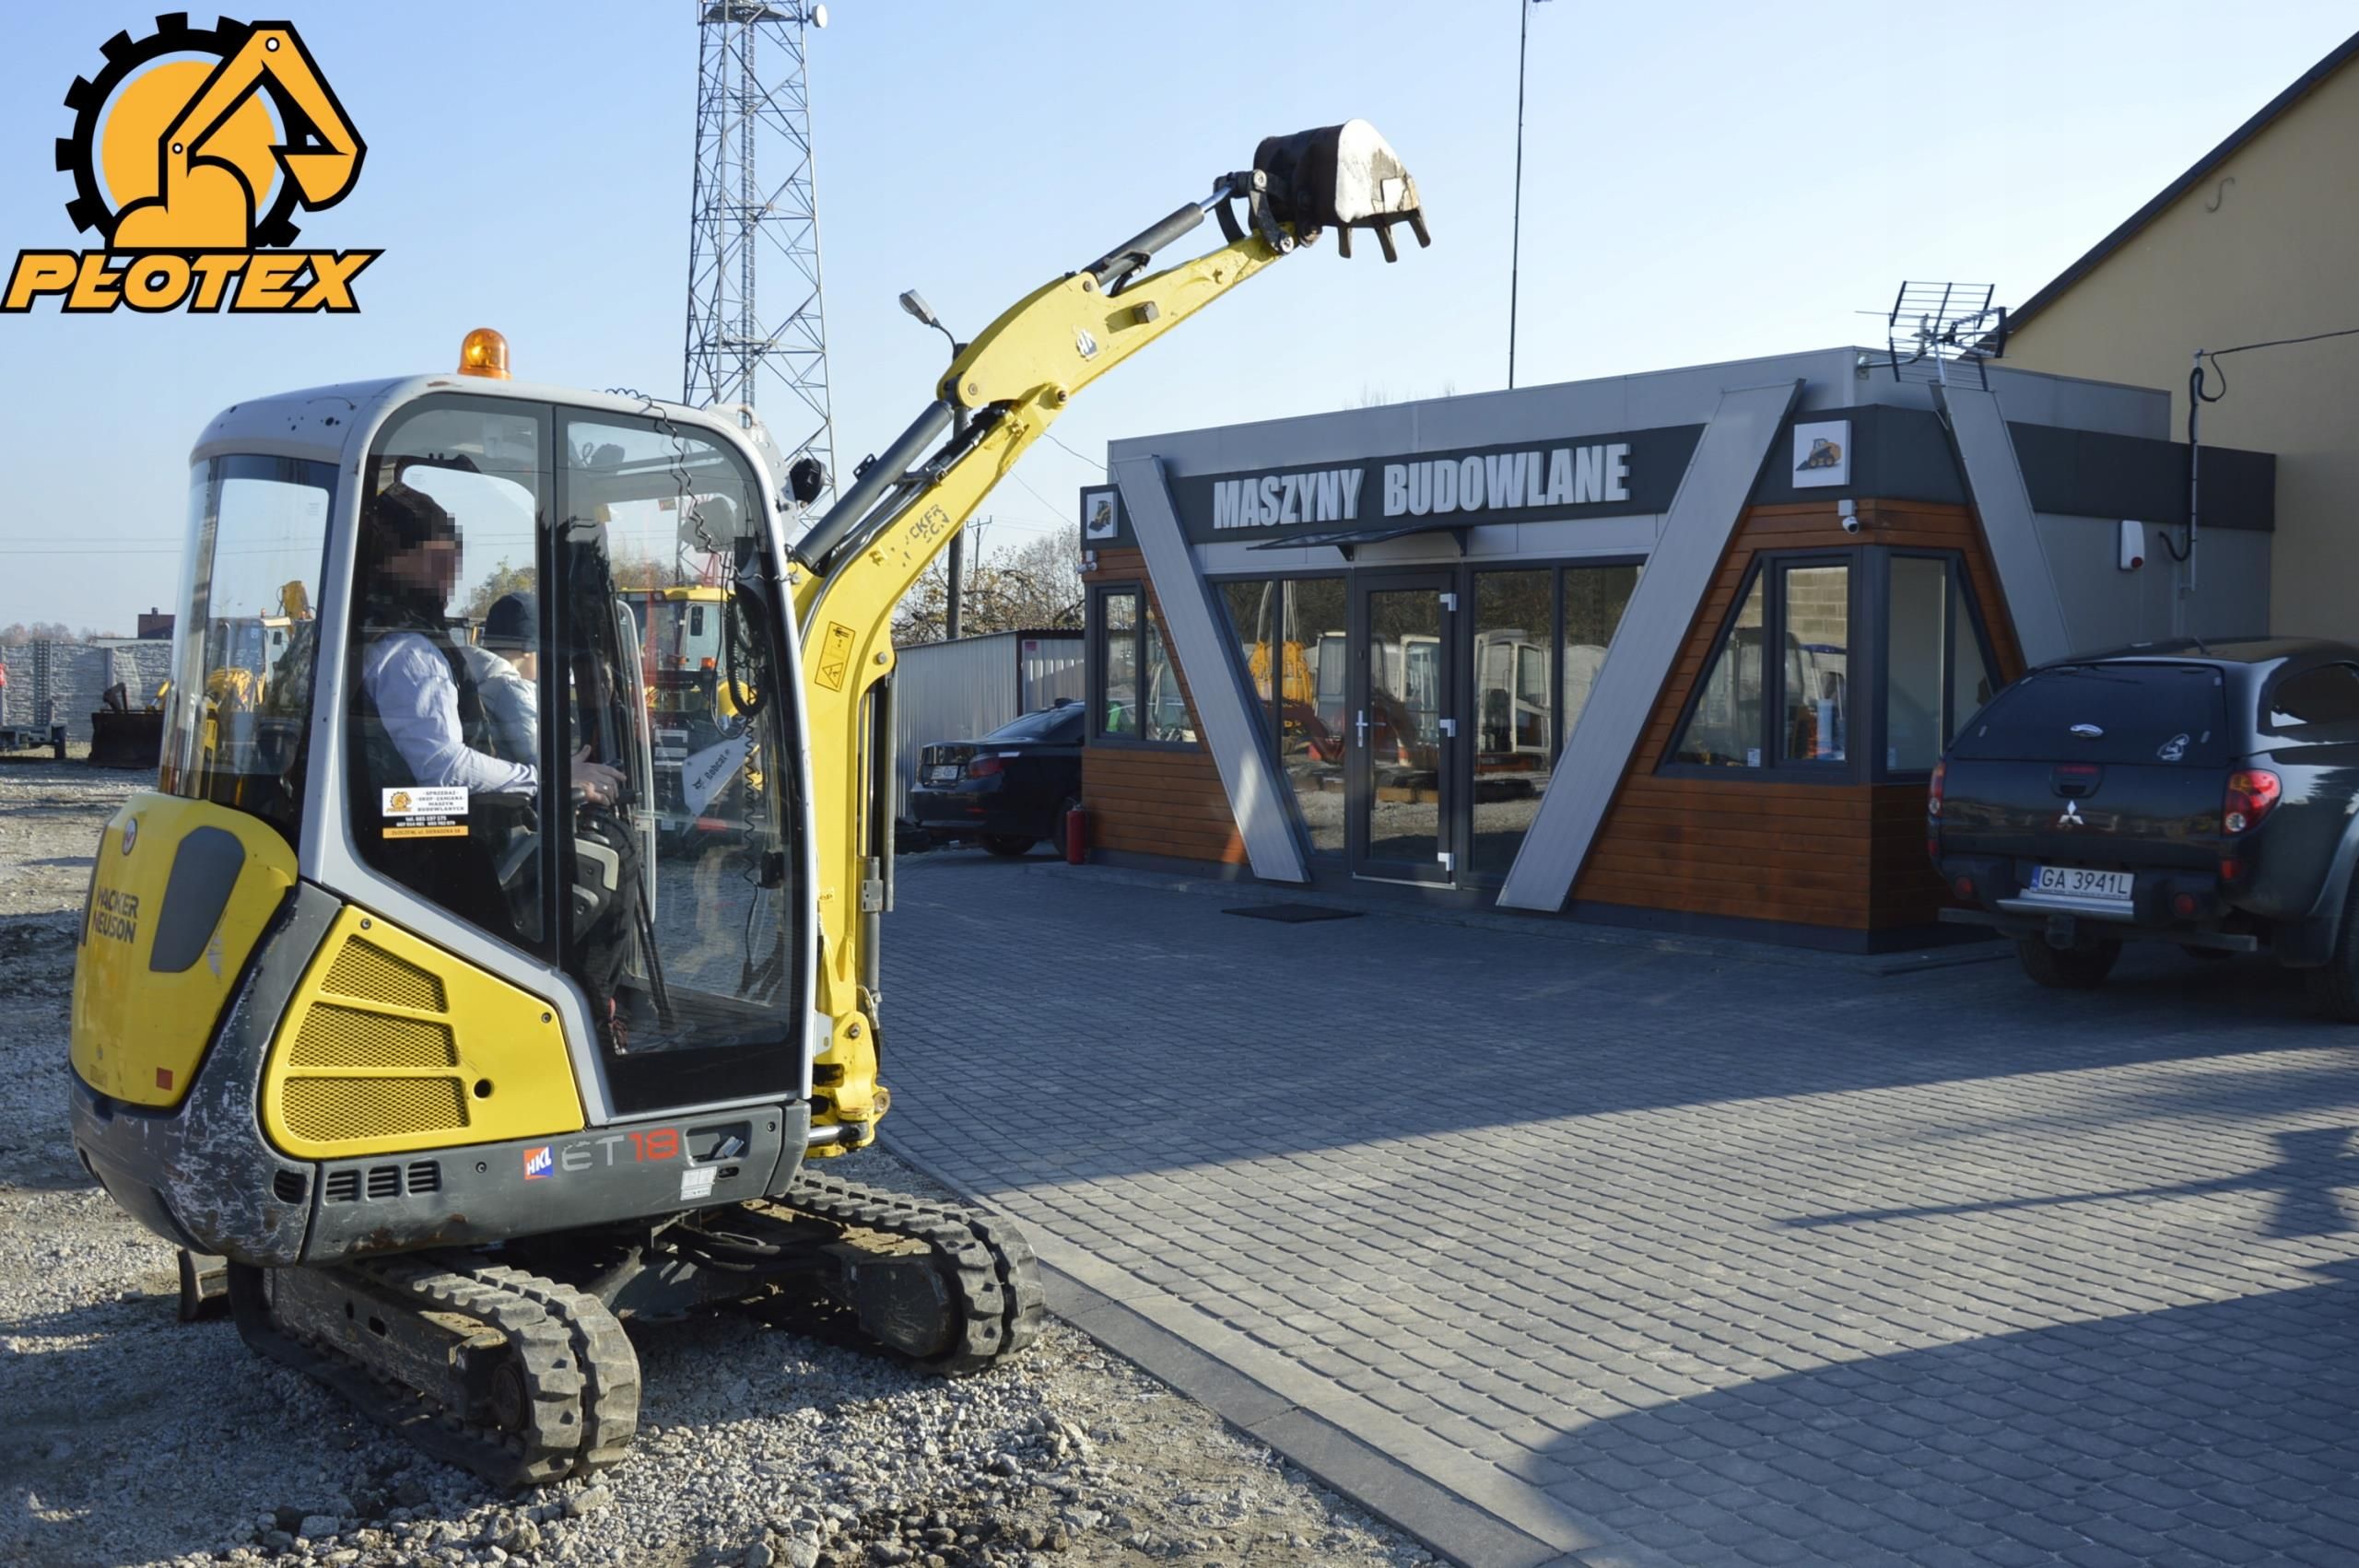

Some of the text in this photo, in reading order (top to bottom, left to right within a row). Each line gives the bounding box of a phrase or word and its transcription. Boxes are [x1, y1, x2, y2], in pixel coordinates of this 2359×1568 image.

[1213, 443, 1630, 529] MASZYNY BUDOWLANE
[704, 755, 728, 779] Bobcat
[2041, 869, 2066, 889] GA
[2072, 872, 2128, 895] 3941L
[526, 1145, 552, 1176] HKL
